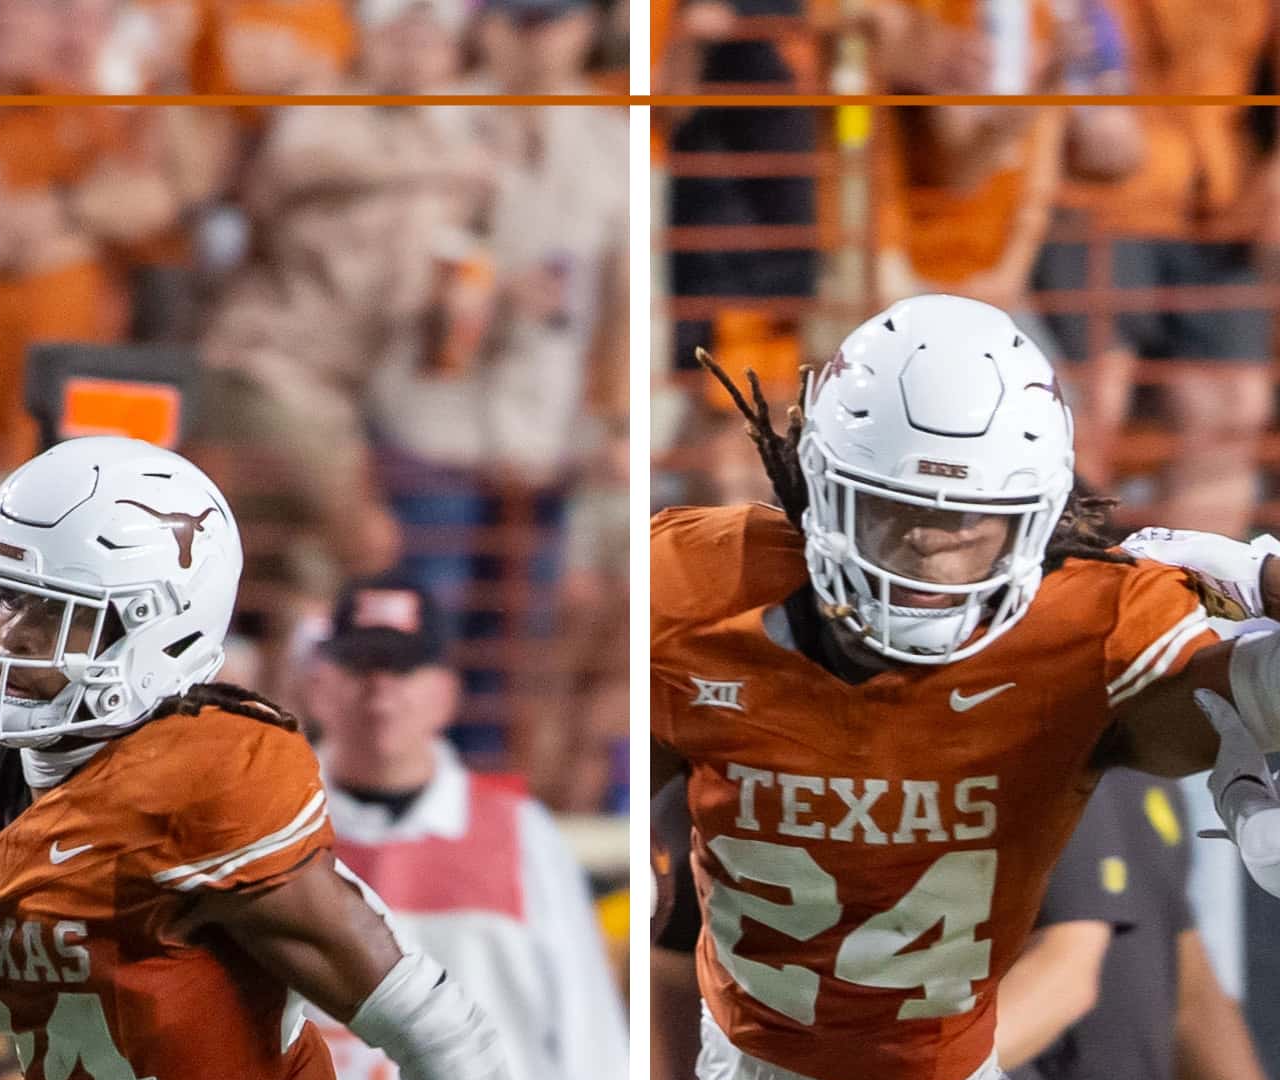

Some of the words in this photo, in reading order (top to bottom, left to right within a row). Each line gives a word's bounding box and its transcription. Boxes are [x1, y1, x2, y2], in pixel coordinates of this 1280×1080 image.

[688, 673, 745, 711] XII
[727, 762, 1000, 845] TEXAS
[706, 834, 999, 1026] 24
